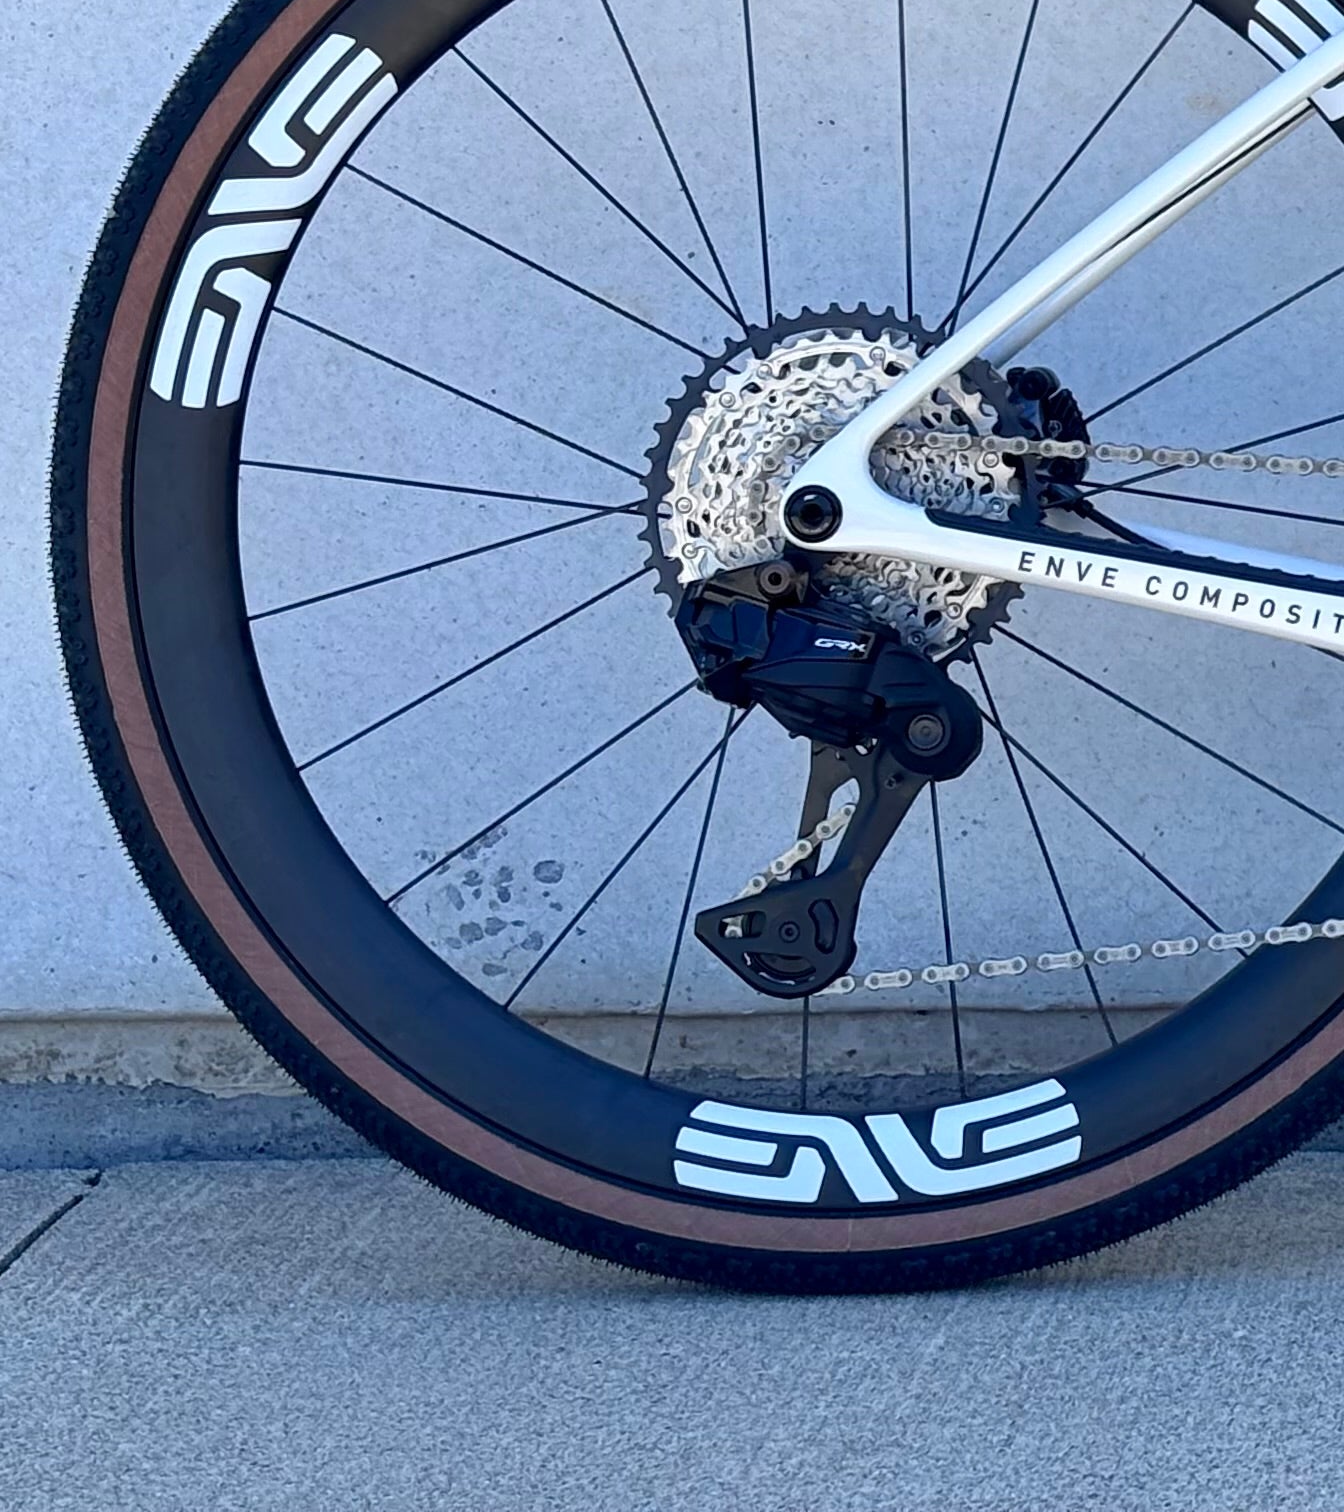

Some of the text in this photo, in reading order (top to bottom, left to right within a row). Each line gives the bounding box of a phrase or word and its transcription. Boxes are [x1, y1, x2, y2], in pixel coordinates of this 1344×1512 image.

[149, 32, 399, 409] ENVE
[1018, 551, 1119, 588] ENVE
[814, 638, 867, 653] GRX
[673, 1077, 1083, 1204] ENVE
